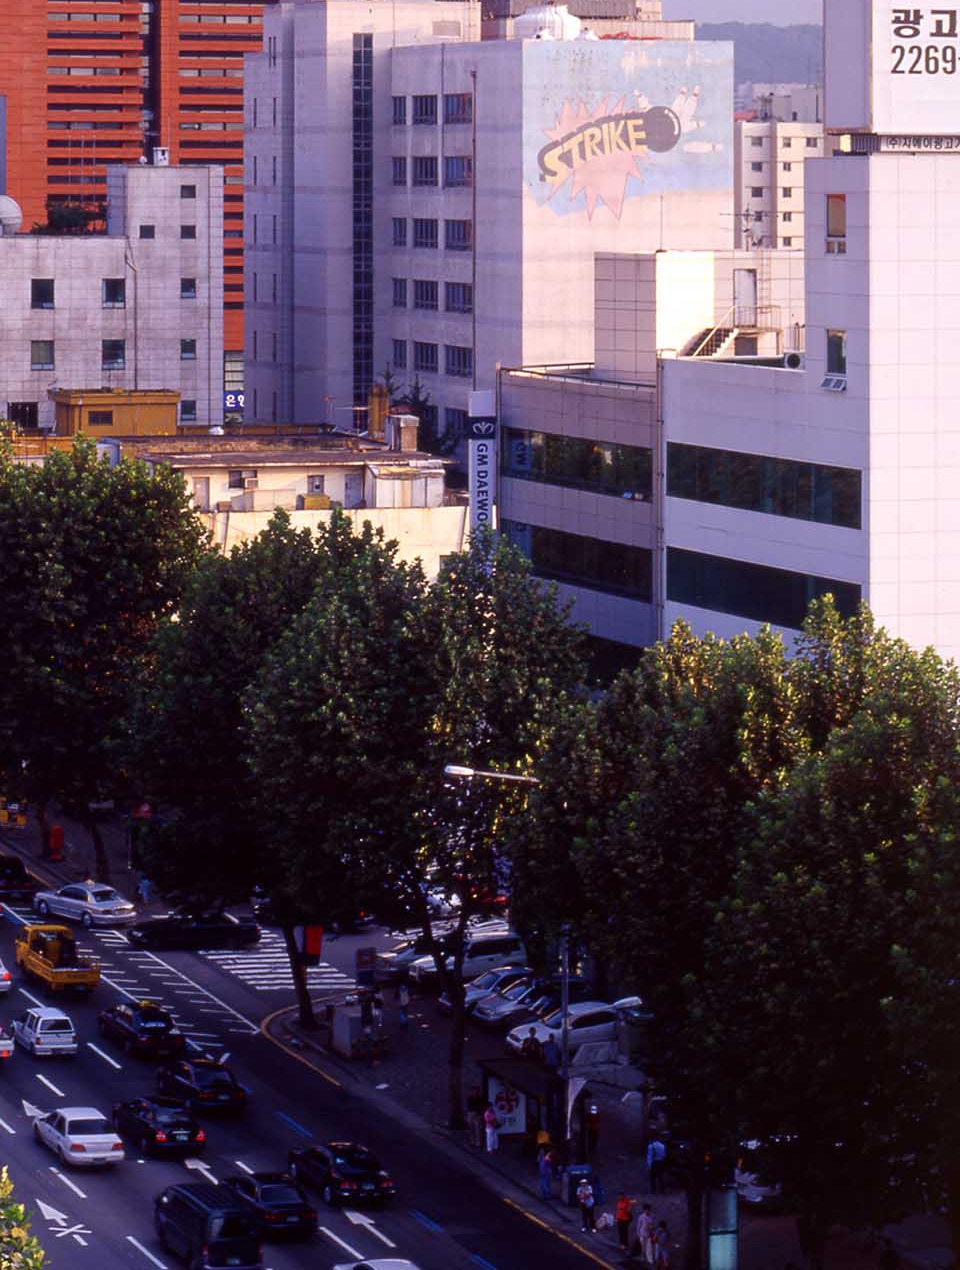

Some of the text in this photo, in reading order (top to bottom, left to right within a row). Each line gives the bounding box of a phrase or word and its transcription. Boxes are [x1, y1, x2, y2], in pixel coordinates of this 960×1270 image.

[891, 9, 958, 39] 광고
[542, 118, 649, 183] STRIKE
[476, 443, 489, 466] GM
